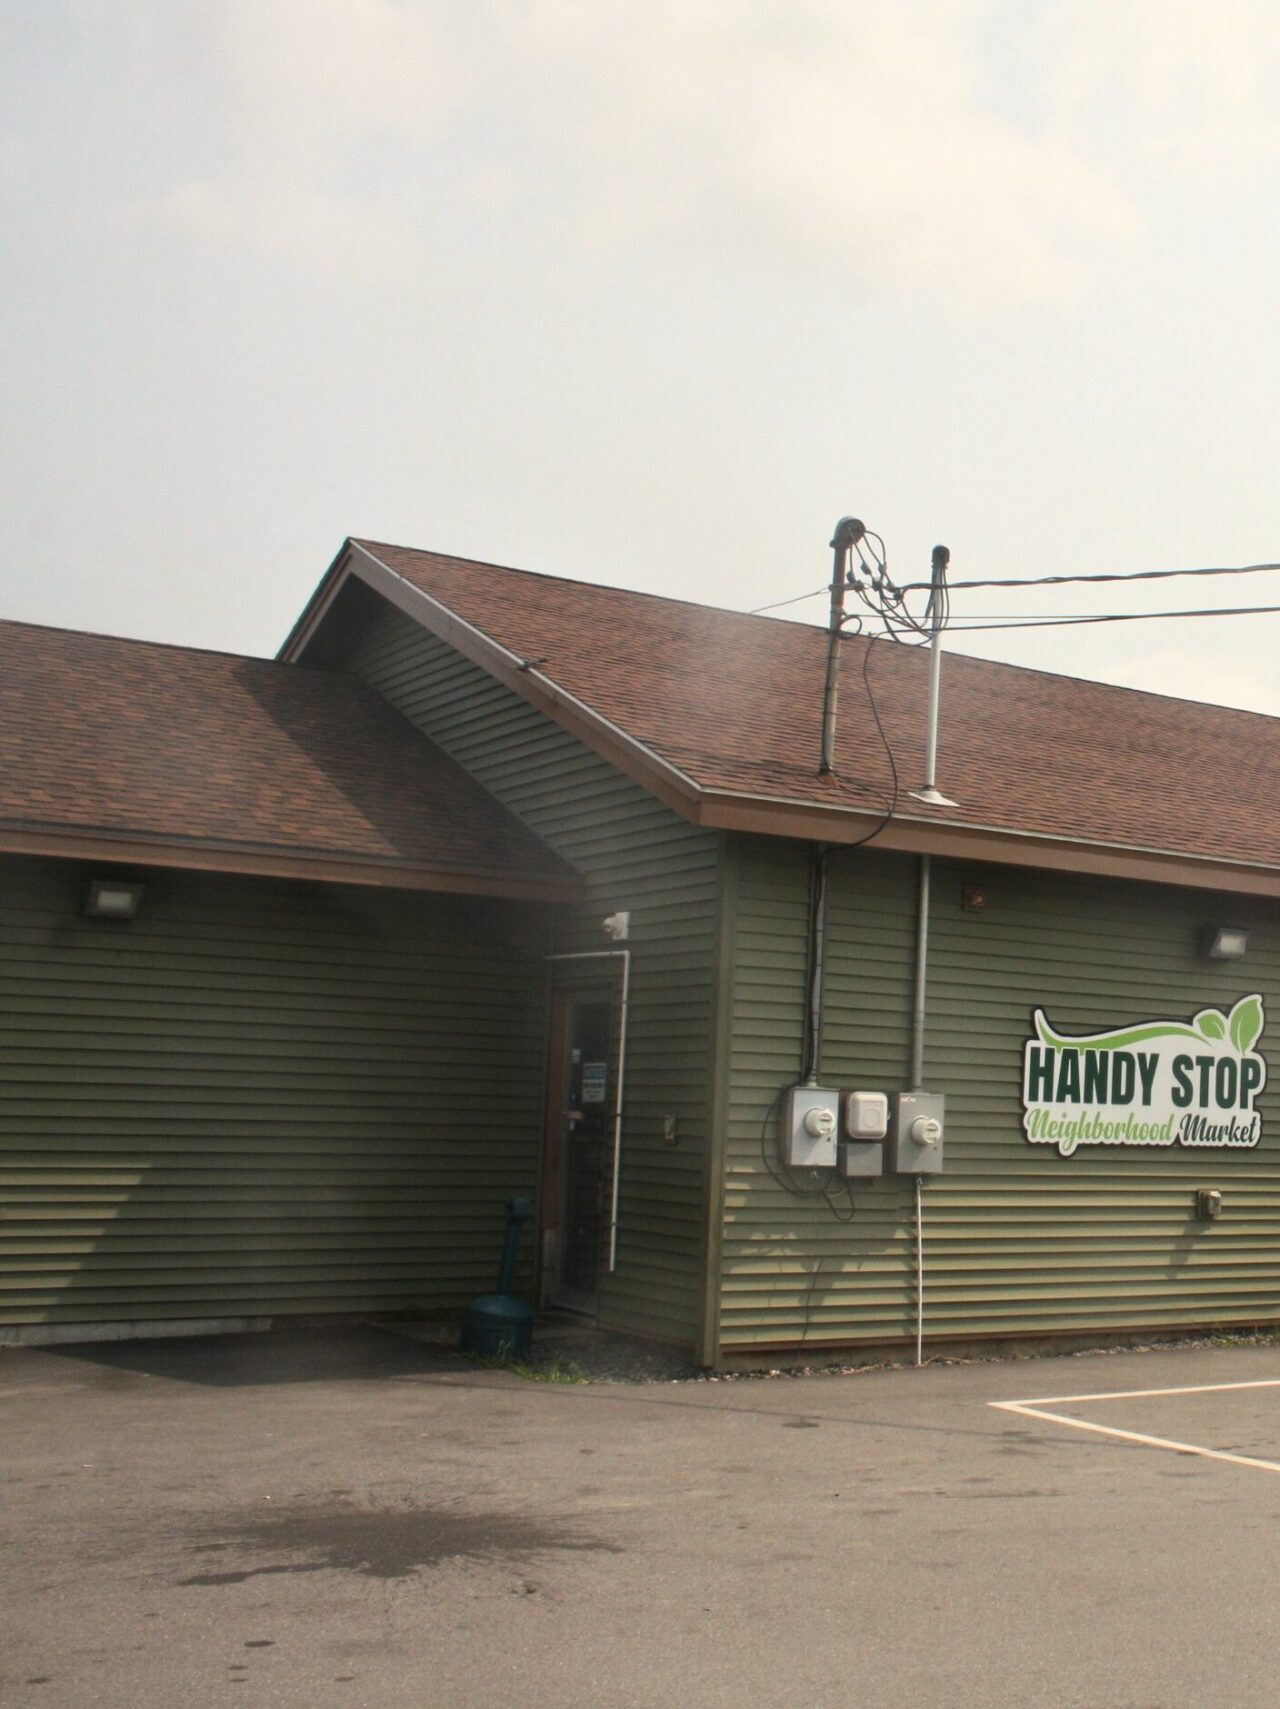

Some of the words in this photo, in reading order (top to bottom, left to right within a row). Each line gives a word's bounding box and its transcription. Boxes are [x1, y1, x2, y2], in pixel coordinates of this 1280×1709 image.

[1028, 1046, 1160, 1106] HANDY
[1171, 1053, 1262, 1110] STOP
[1027, 1108, 1175, 1151] Neighborhood
[1180, 1113, 1258, 1143] Market
